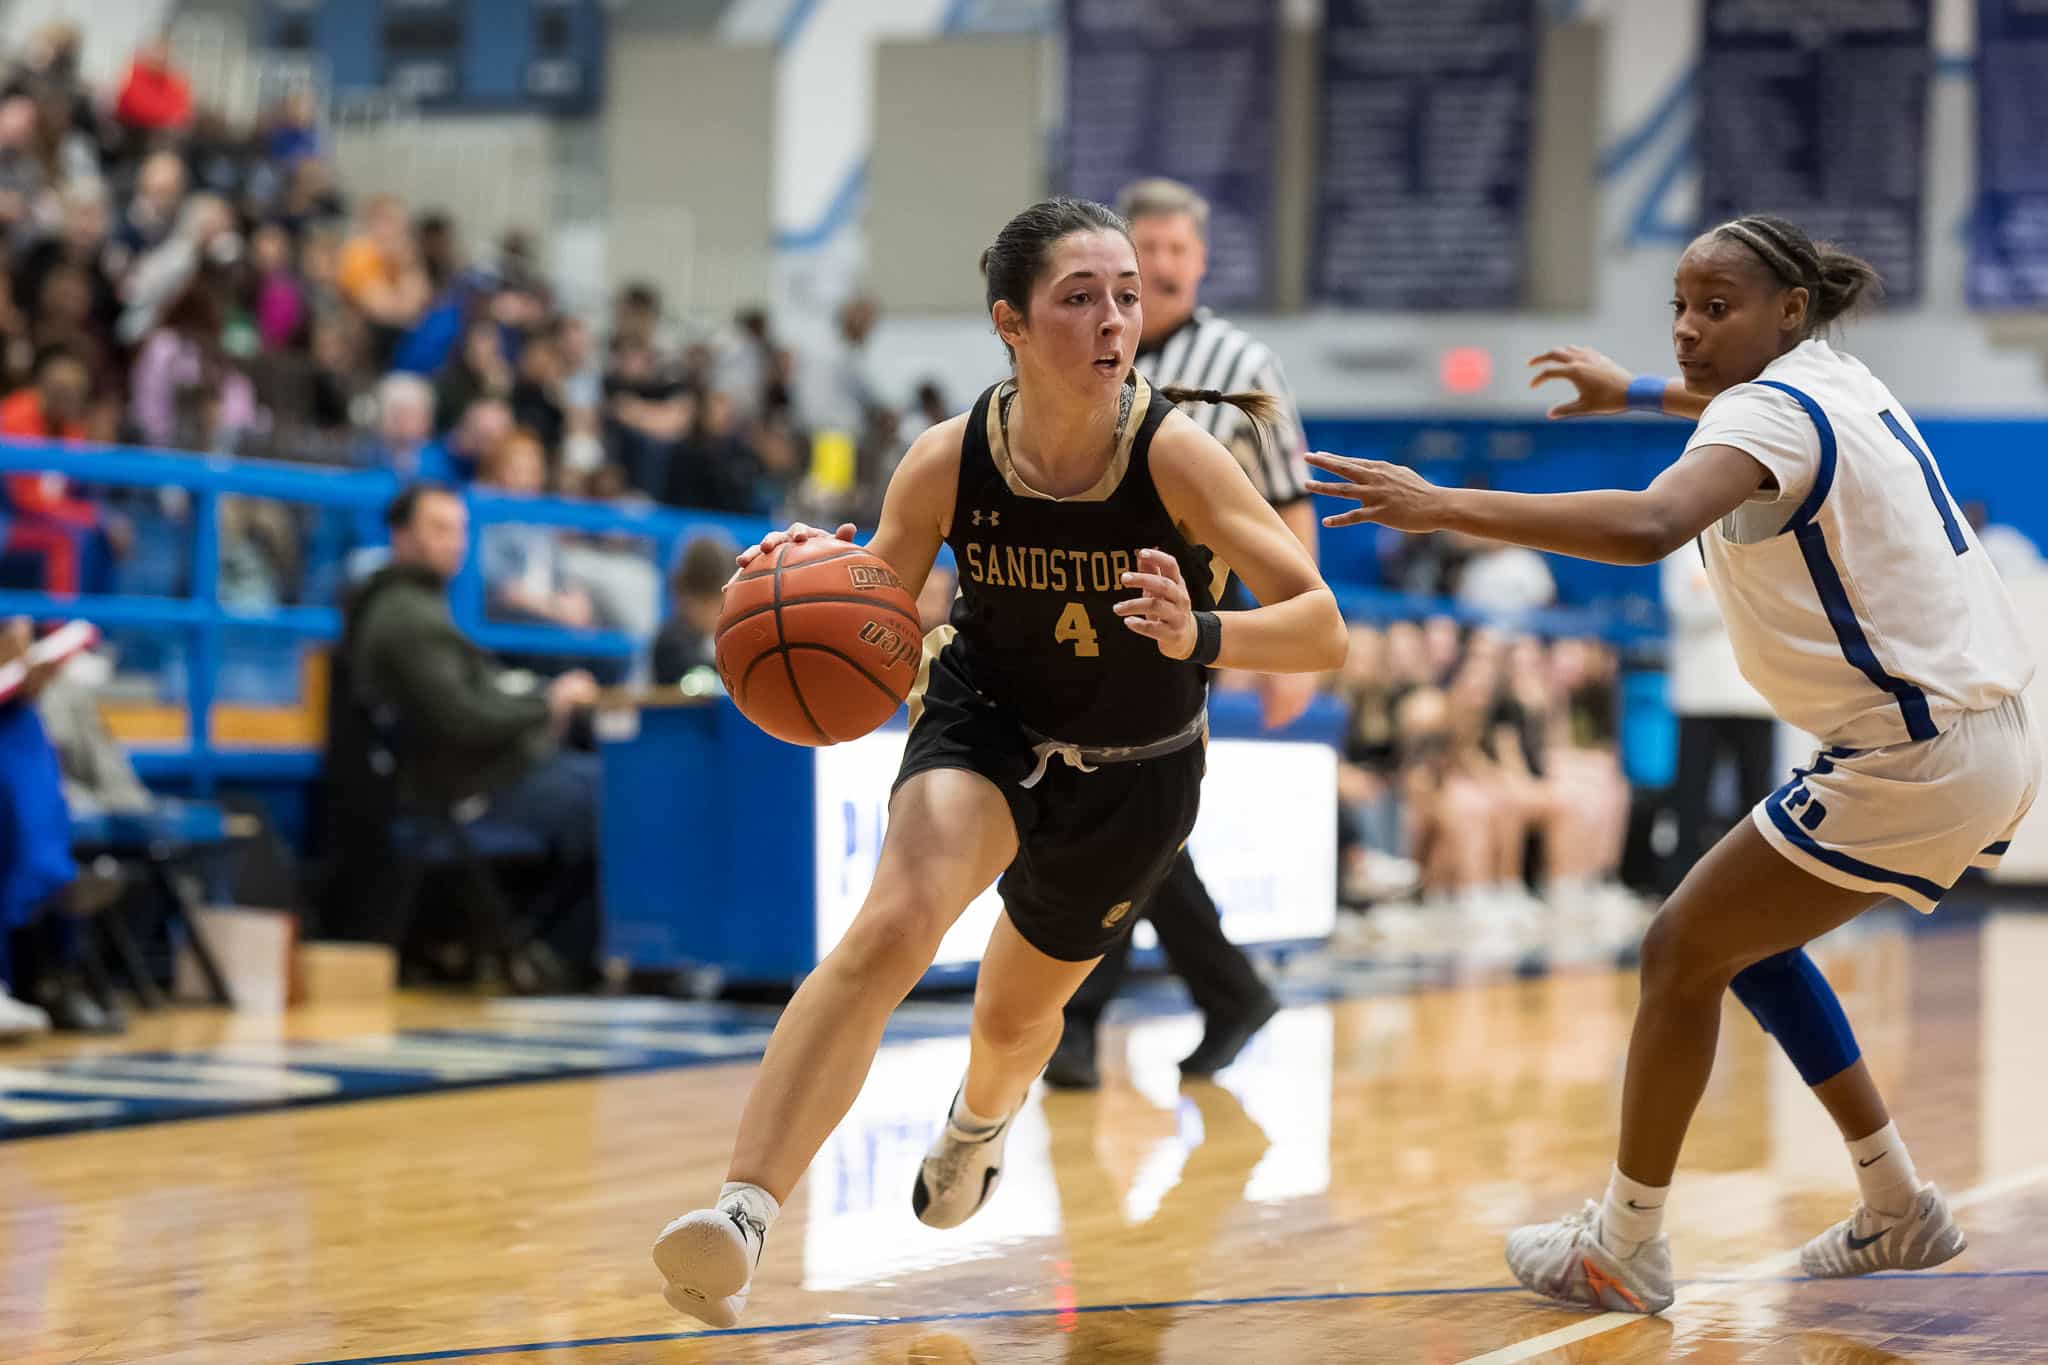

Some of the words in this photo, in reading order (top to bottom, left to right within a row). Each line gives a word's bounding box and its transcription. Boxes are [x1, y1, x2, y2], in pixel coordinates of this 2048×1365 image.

[1878, 408, 1970, 557] 1
[966, 542, 1150, 593] SANDSTOR
[1054, 601, 1100, 657] 4
